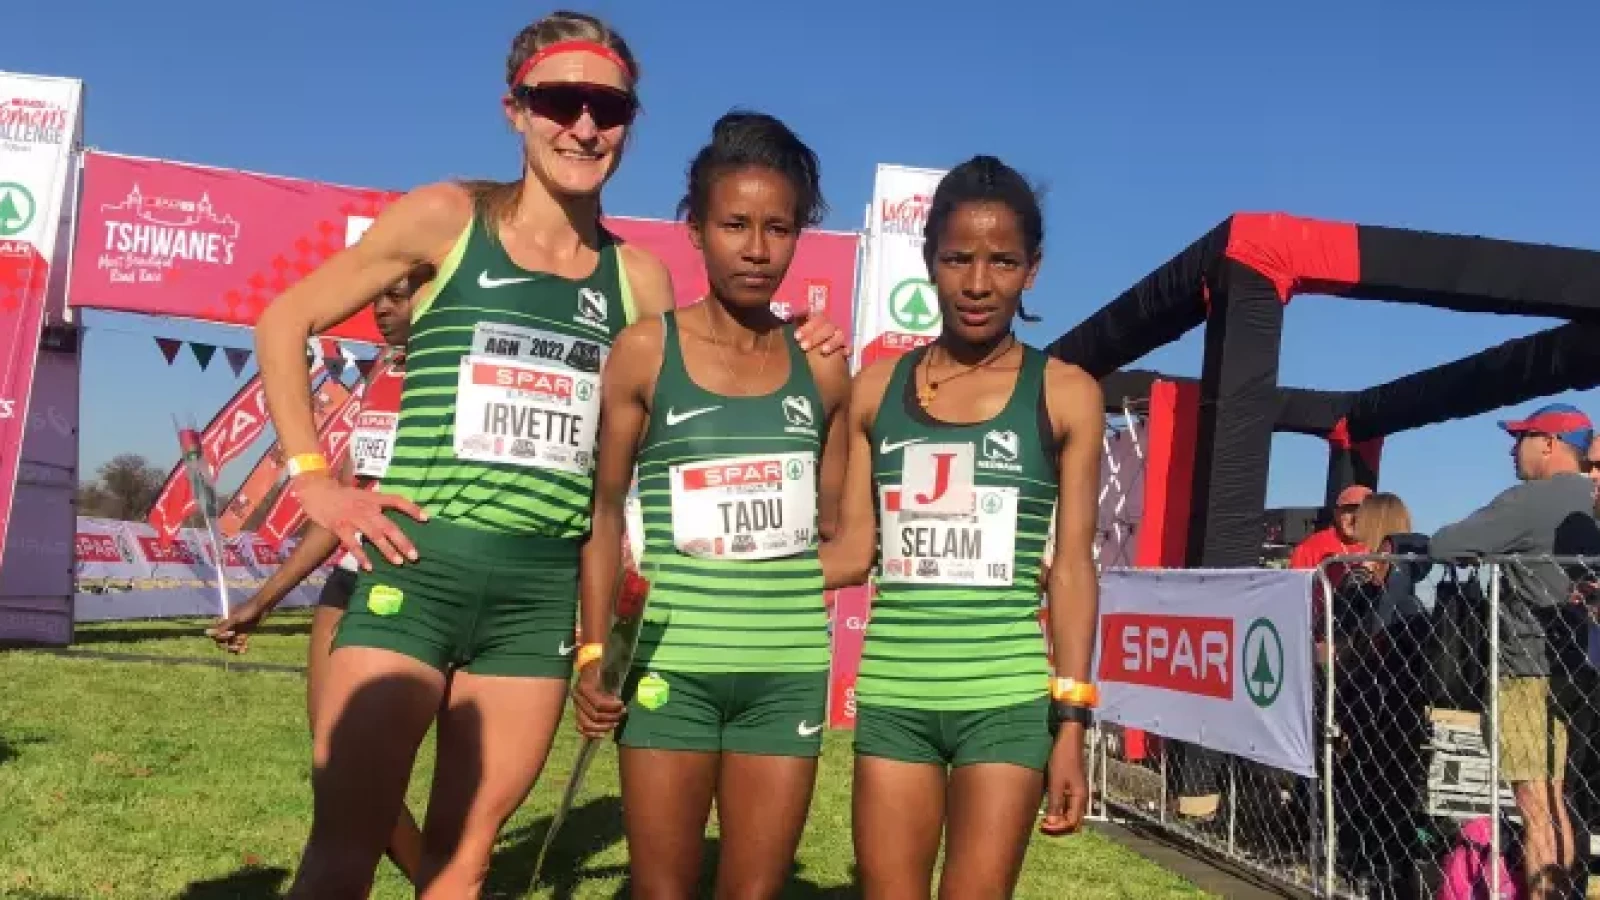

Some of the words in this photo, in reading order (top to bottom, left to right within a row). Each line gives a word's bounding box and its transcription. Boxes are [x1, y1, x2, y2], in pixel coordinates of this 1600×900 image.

[0, 125, 63, 144] ALLENGE
[529, 337, 565, 362] 2022
[496, 369, 572, 396] SPAR
[483, 402, 584, 447] IRVETTE
[704, 463, 781, 486] SPAR
[914, 453, 958, 505] J
[716, 498, 782, 534] TADU
[901, 527, 982, 560] SELAM
[1122, 625, 1229, 685] SPAR
